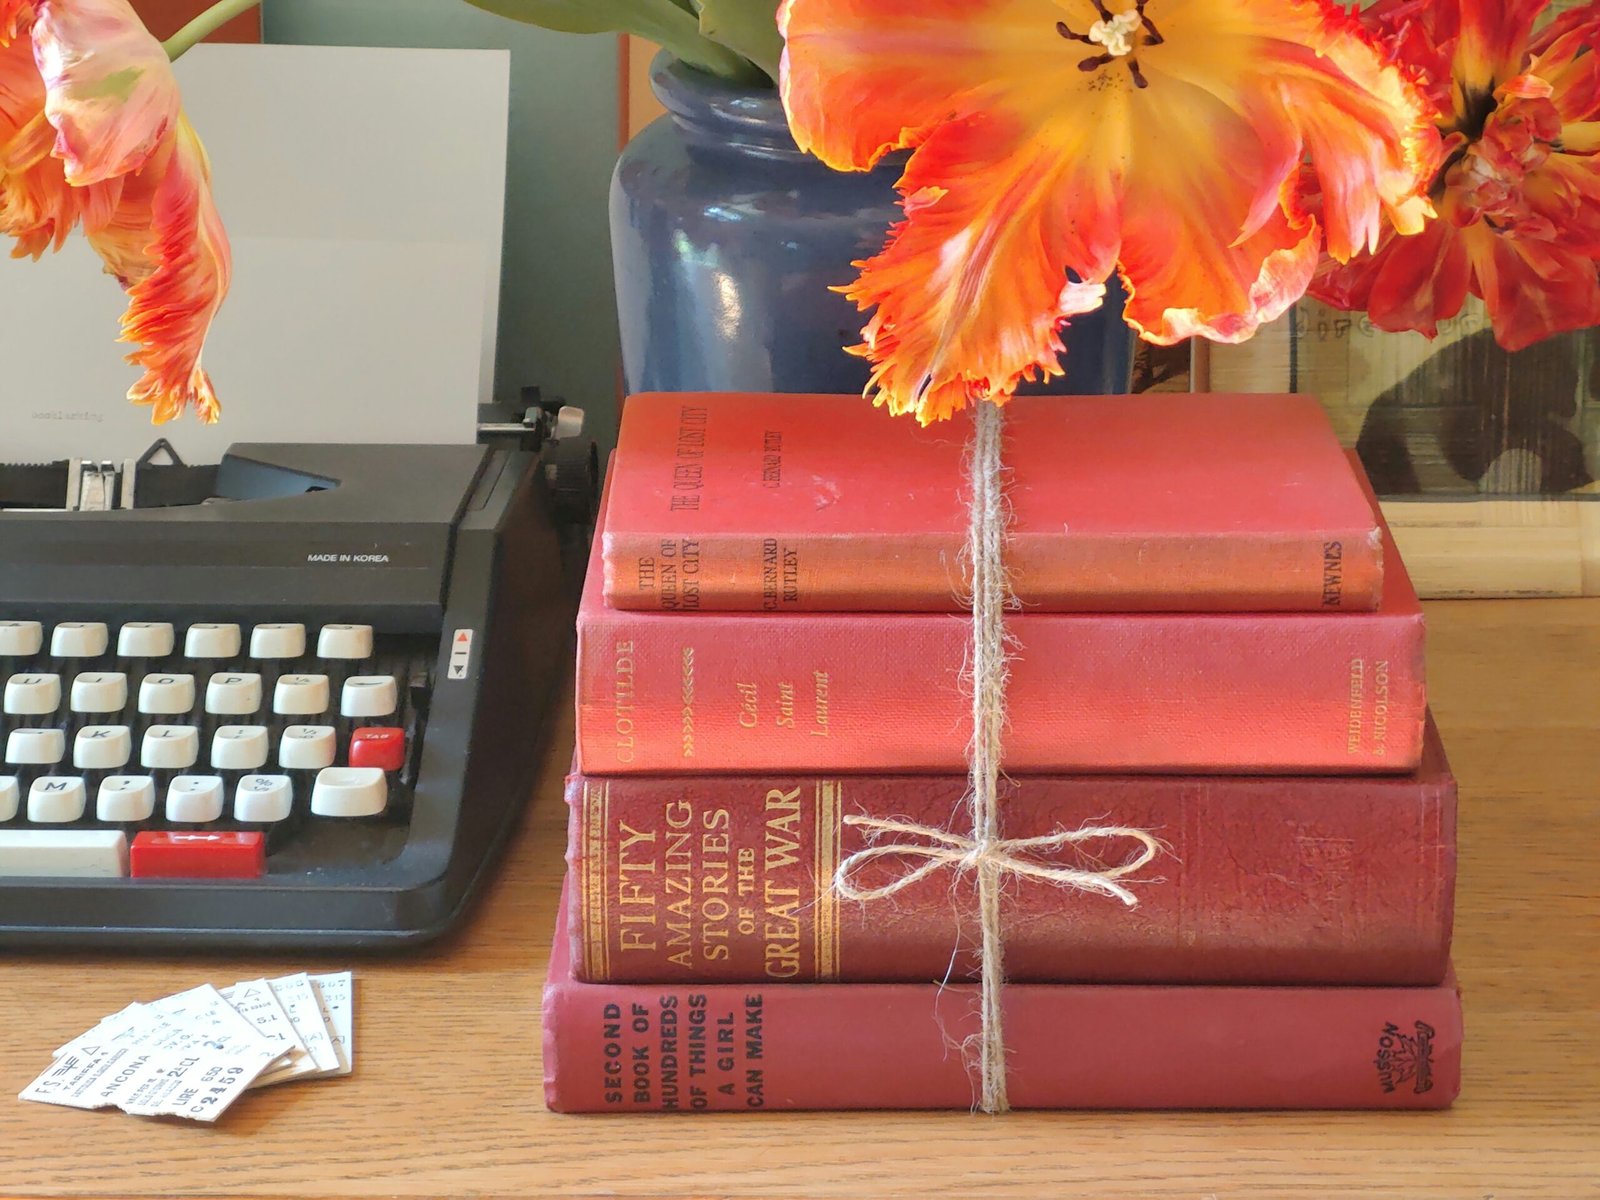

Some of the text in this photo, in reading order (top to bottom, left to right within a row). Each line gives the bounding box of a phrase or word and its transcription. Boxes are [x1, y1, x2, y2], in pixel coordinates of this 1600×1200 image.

[670, 495, 700, 511] THE
[307, 553, 389, 563] MADE IN KOREA
[639, 556, 655, 590] THE
[661, 538, 680, 609] QUEEN OF
[682, 539, 700, 609] LOST CITY
[783, 547, 798, 602] RUTLEY
[1322, 541, 1342, 606] NEWNES
[616, 640, 634, 763] CLOTILDE
[776, 681, 795, 729] Saint
[810, 669, 829, 737] Laurent
[1348, 658, 1364, 754] WEIDENFELD
[1374, 660, 1389, 743] NICOLSON
[44, 782, 68, 790] M
[619, 820, 657, 952] FIFTY
[665, 799, 693, 970] AMAZING
[702, 808, 730, 960] STORIES
[737, 848, 755, 935] OF THE
[765, 786, 801, 978] GREAT WAR
[63, 1058, 101, 1091] TARIFFA
[100, 1055, 150, 1098] ANCONA
[604, 1003, 622, 1104] SECOND
[632, 1003, 650, 1103] BOOK OF
[660, 995, 679, 1111] HUNDREDS
[688, 993, 707, 1112] OF THINGS
[718, 1012, 735, 1095] A GIRL
[745, 994, 764, 1107] CAN MAKE
[1376, 1020, 1399, 1094] MUSSON
[171, 1088, 199, 1107] LIRE
[190, 1105, 204, 1113] C
[200, 1067, 244, 1106] 2459
